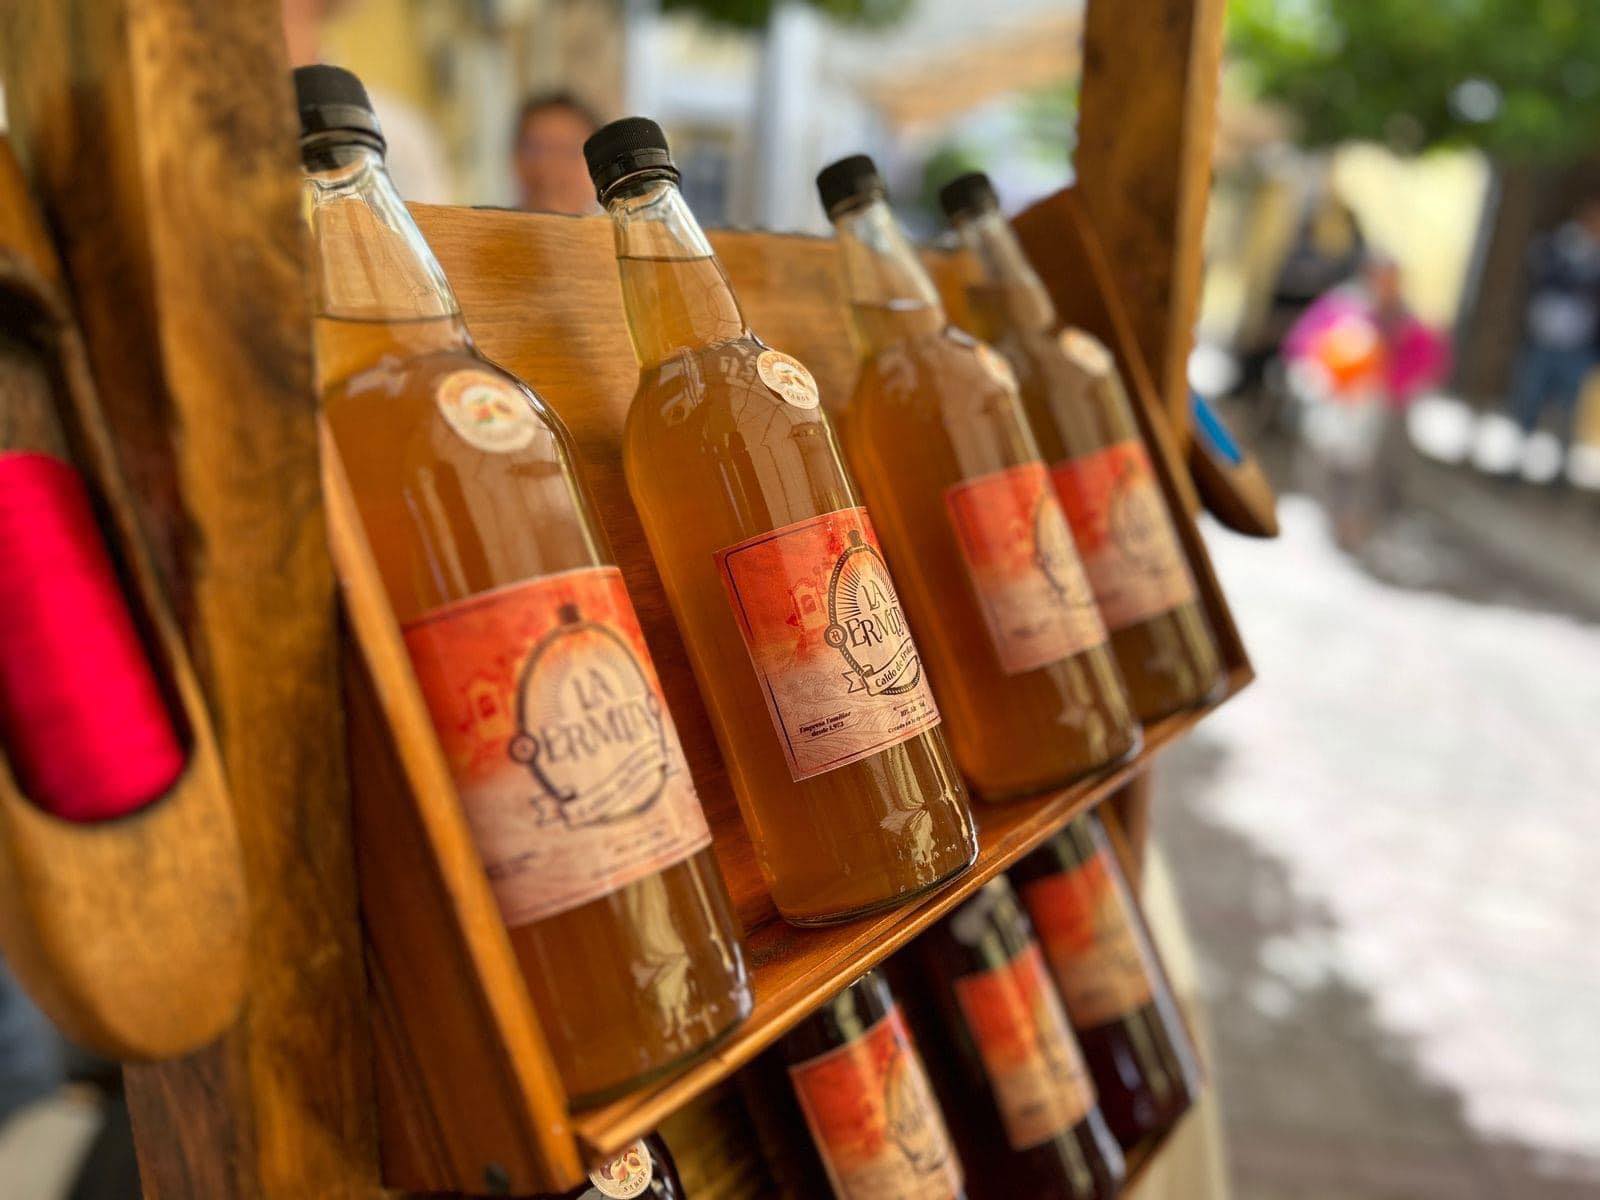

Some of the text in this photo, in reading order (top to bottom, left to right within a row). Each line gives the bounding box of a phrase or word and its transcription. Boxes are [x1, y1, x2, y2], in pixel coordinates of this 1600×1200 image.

[861, 579, 887, 611] LA
[571, 666, 616, 712] LA
[875, 668, 898, 688] Caldo
[895, 660, 904, 672] de
